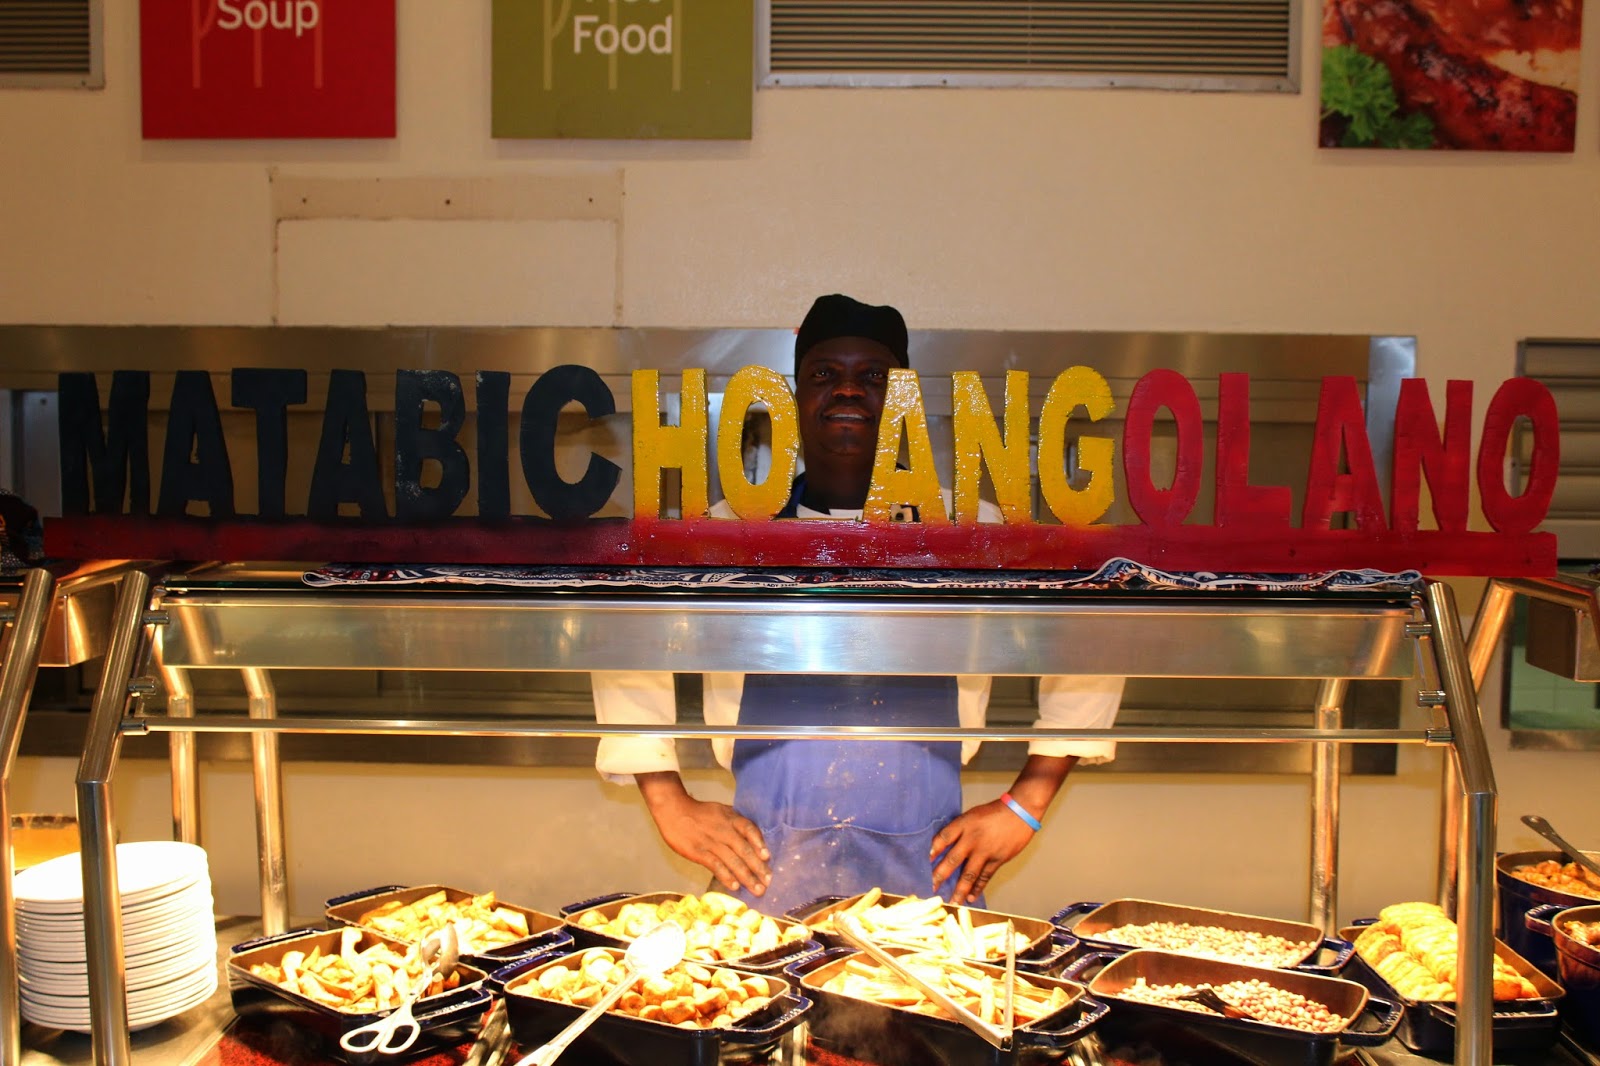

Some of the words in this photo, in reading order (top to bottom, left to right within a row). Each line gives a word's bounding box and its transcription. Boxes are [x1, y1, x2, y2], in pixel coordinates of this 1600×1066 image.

[218, 0, 319, 37] Soup
[574, 15, 673, 54] Food
[58, 364, 799, 523] MATABICHO
[862, 365, 1560, 535] ANGOLANO
